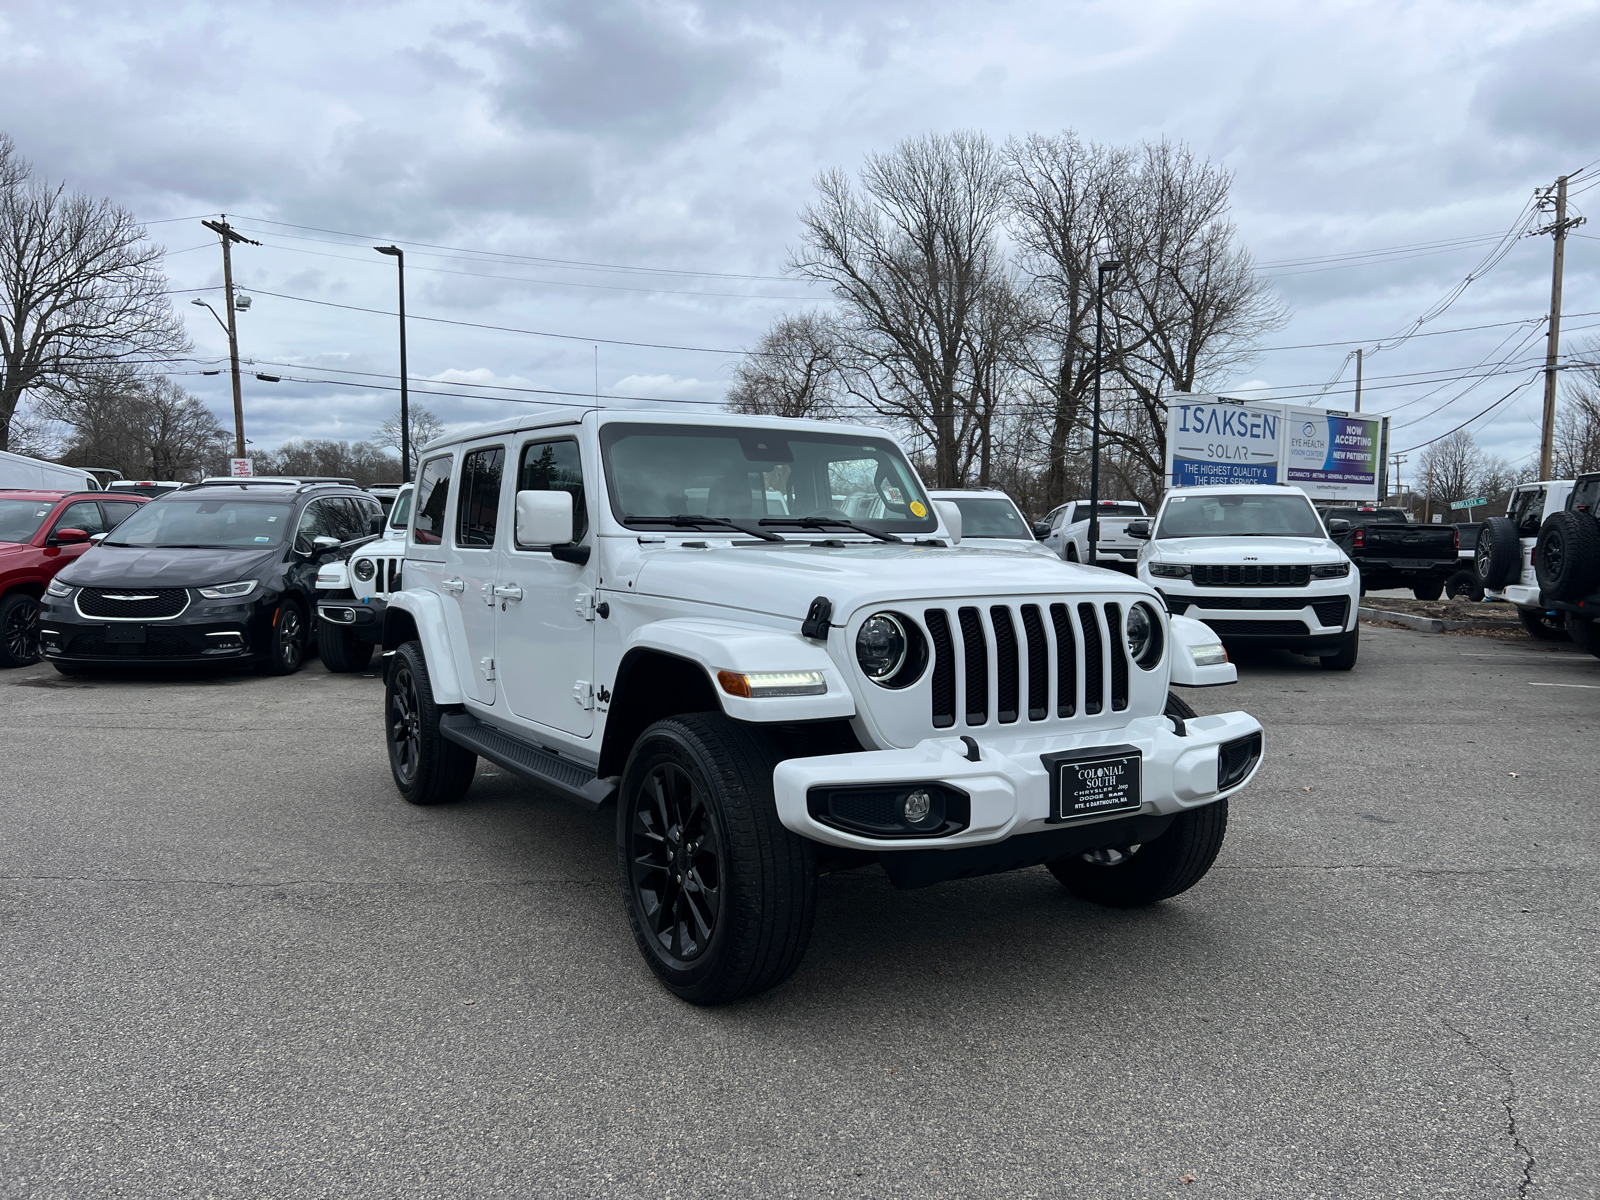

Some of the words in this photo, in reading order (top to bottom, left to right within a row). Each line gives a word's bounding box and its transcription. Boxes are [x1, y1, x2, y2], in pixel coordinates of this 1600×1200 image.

[1179, 405, 1276, 440] ISAKSEN
[1346, 425, 1363, 436] NOW
[1291, 438, 1302, 447] EYE
[1303, 438, 1325, 449] HEALTH
[1334, 434, 1372, 446] ACCEPTING
[1207, 443, 1249, 460] SOLAR
[1291, 448, 1305, 456] VISION
[1305, 449, 1324, 458] CENTERS
[1332, 450, 1346, 459] NEW
[1346, 451, 1372, 462] PATIENTS!
[1184, 463, 1199, 474] THE
[1200, 464, 1231, 476] HIGHEST
[1232, 466, 1262, 478] QUALITY
[1262, 468, 1268, 478] &
[1194, 475, 1208, 485] THE
[1210, 476, 1228, 485] BEST
[1078, 765, 1124, 780] COLONIAL
[1086, 775, 1116, 789] SOUTH
[1074, 787, 1112, 796] CHRYSLER
[1079, 794, 1104, 802] DODGE
